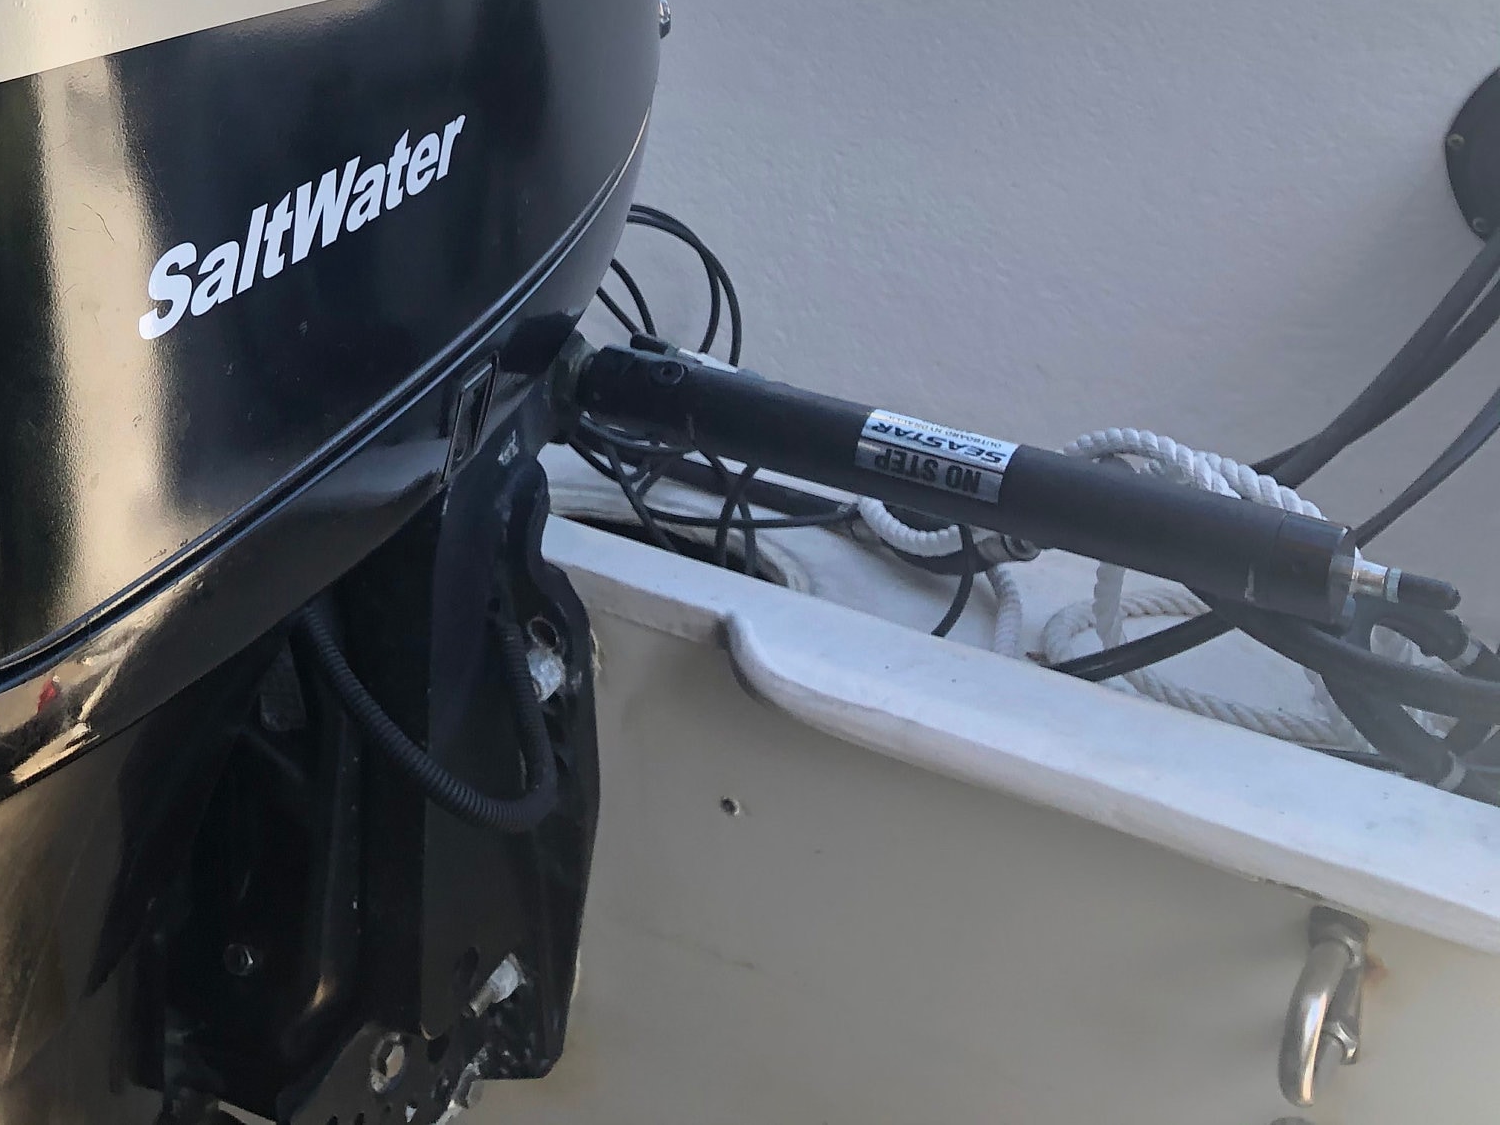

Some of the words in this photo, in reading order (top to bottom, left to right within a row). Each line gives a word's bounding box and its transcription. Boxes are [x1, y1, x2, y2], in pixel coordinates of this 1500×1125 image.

[138, 114, 466, 340] SaltWater
[875, 448, 939, 483] STEP
[946, 464, 982, 493] NO
